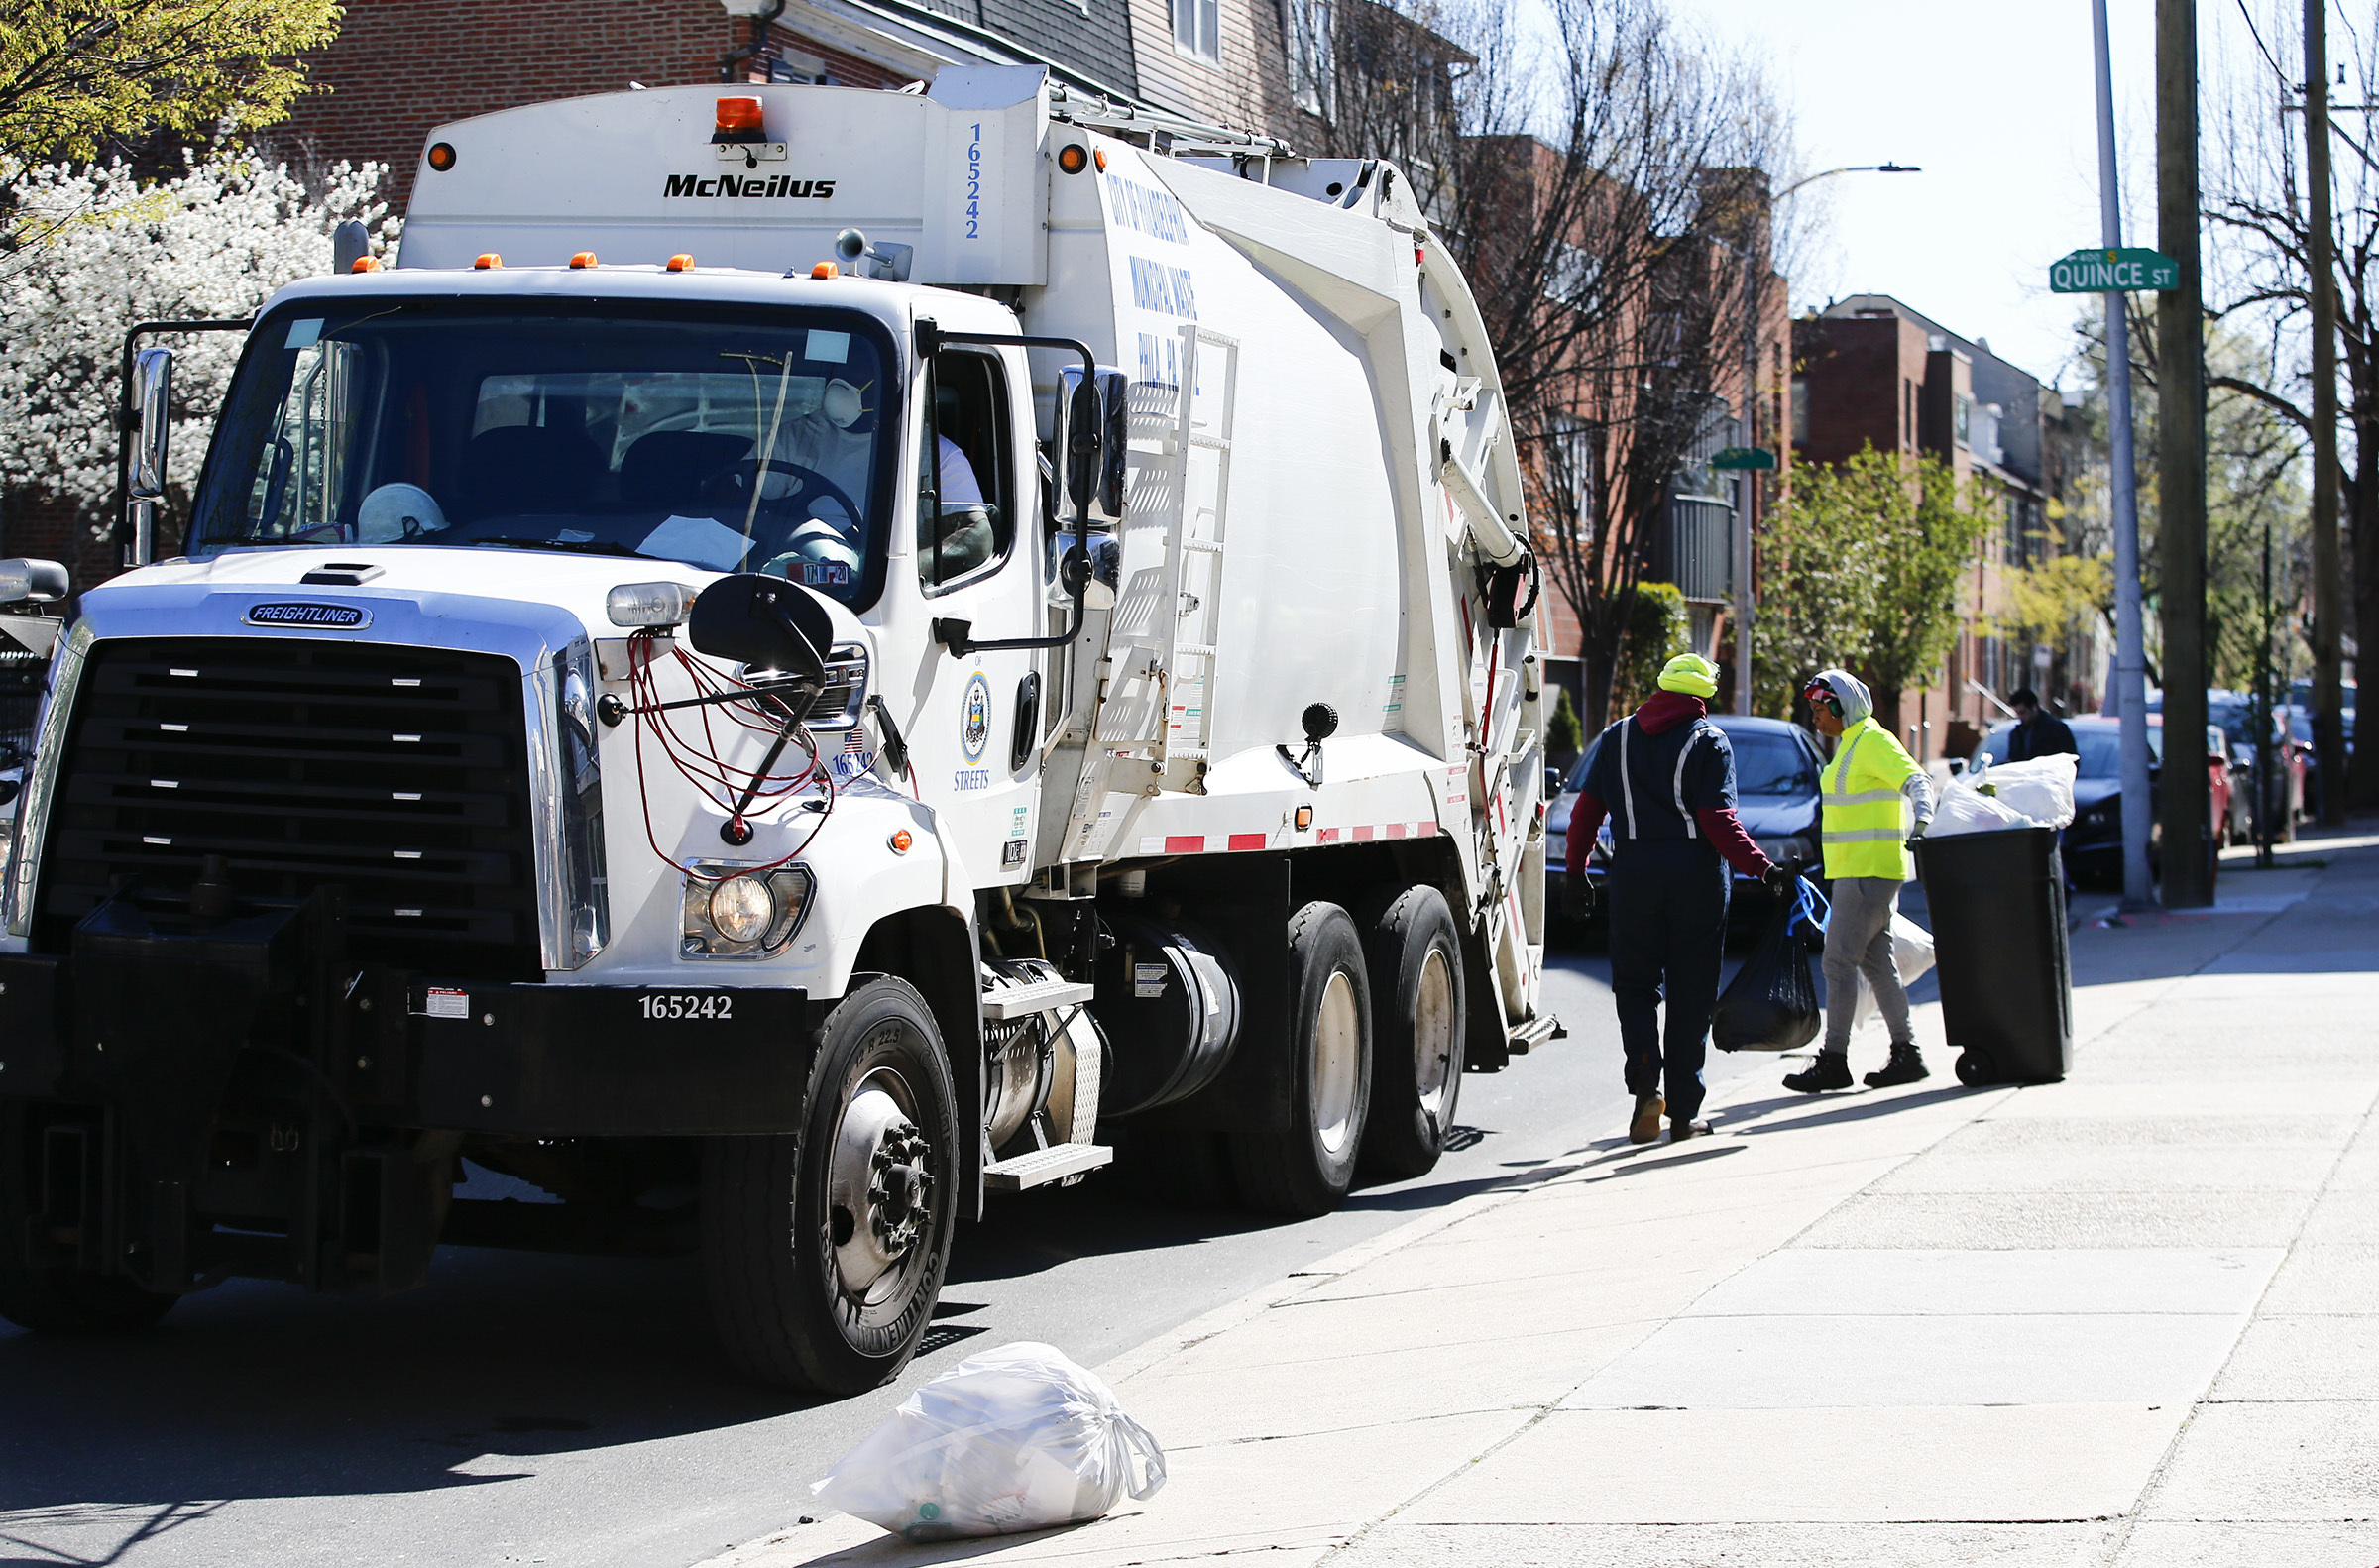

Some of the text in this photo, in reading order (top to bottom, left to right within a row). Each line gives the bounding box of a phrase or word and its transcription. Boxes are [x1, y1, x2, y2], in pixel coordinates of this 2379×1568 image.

[663, 174, 837, 199] McNeilus
[966, 123, 981, 239] 165242
[1106, 172, 1130, 228] CITY
[1125, 178, 1141, 231] OF
[2106, 251, 2117, 263] S
[1129, 255, 1197, 321] MUNICIPAL WASTE
[2054, 262, 2171, 290] QUINCE ST
[253, 607, 358, 622] FREIGHTLINER
[954, 769, 989, 791] STREETS
[638, 995, 733, 1019] 165242
[878, 1027, 901, 1047] 22.5
[856, 1251, 941, 1350] CONTINENTAL
